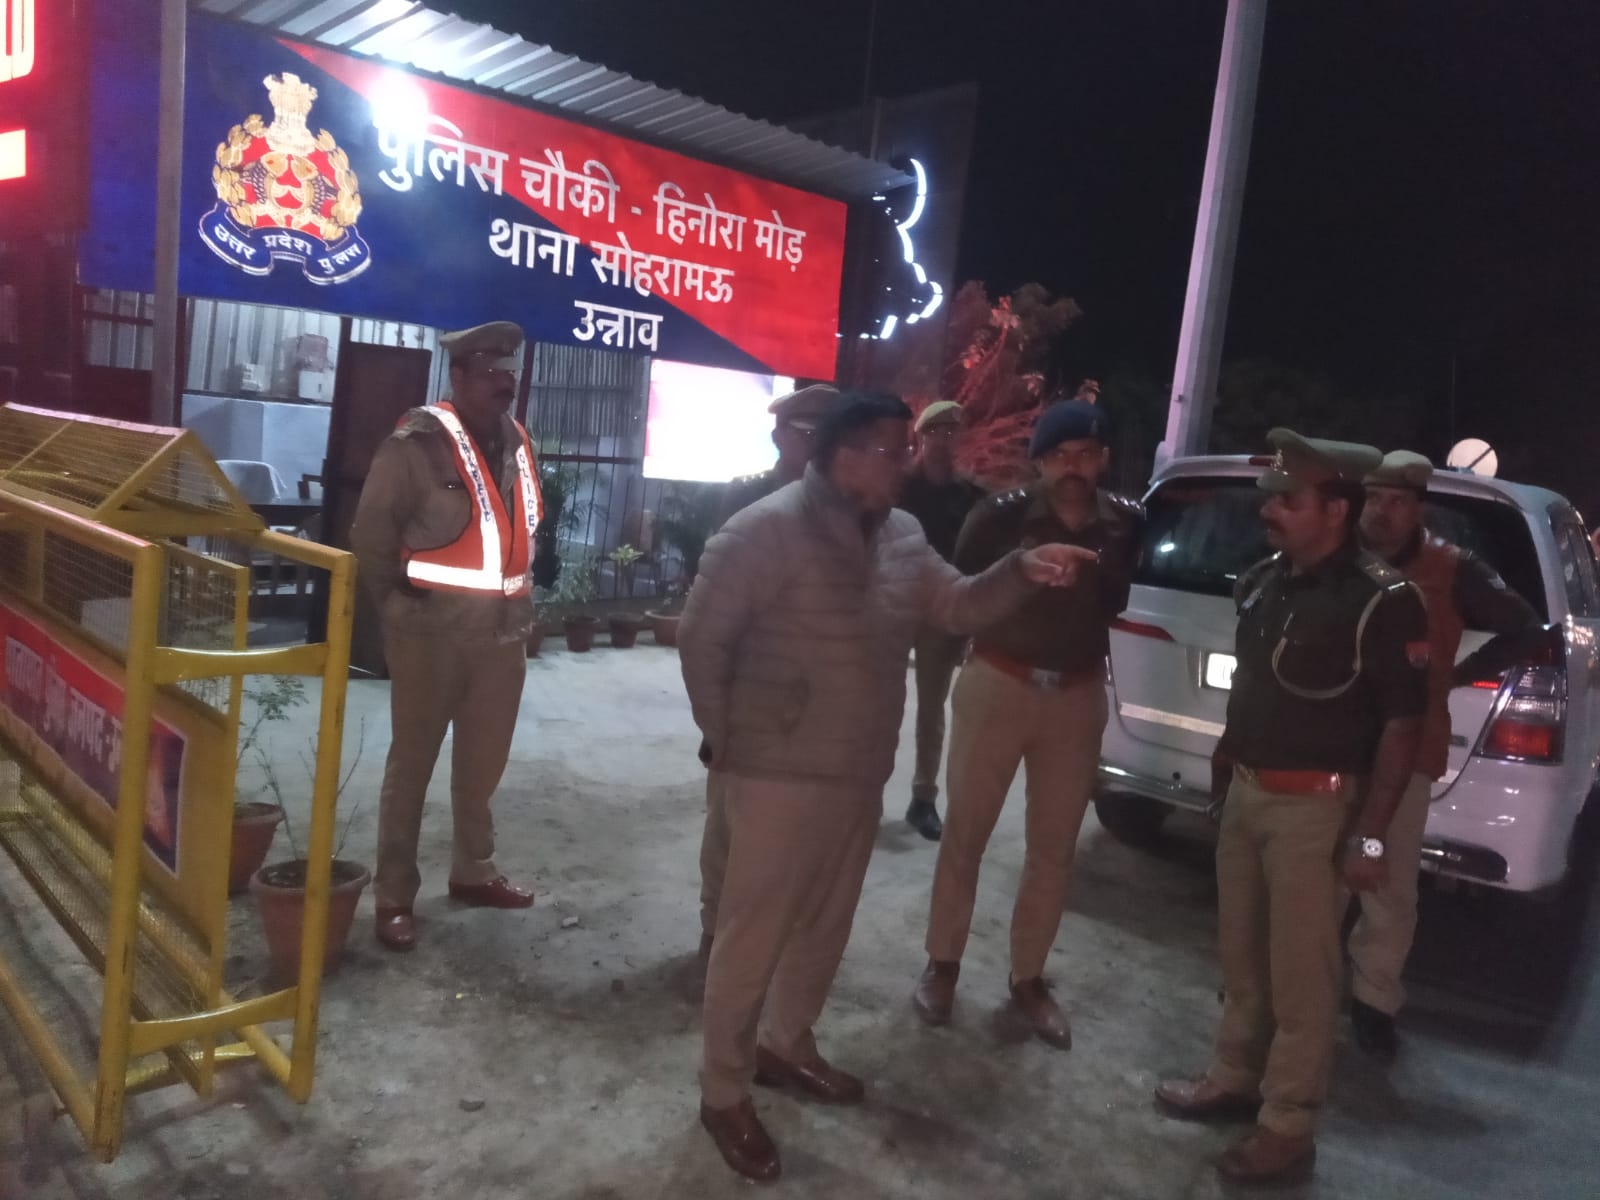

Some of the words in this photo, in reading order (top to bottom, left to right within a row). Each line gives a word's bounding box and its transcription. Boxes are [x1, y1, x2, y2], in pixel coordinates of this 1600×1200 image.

[373, 113, 509, 196] पुलिस
[519, 148, 620, 223] चौकी
[652, 181, 747, 252] हिनोरा
[753, 209, 806, 272] मोड़
[214, 224, 257, 260] उत्तर
[262, 231, 313, 256] प्रदेश
[489, 218, 580, 277] थाना
[590, 231, 735, 304] सोहरामऊ
[572, 300, 663, 352] उन्नाव
[519, 454, 536, 527] OLICE
